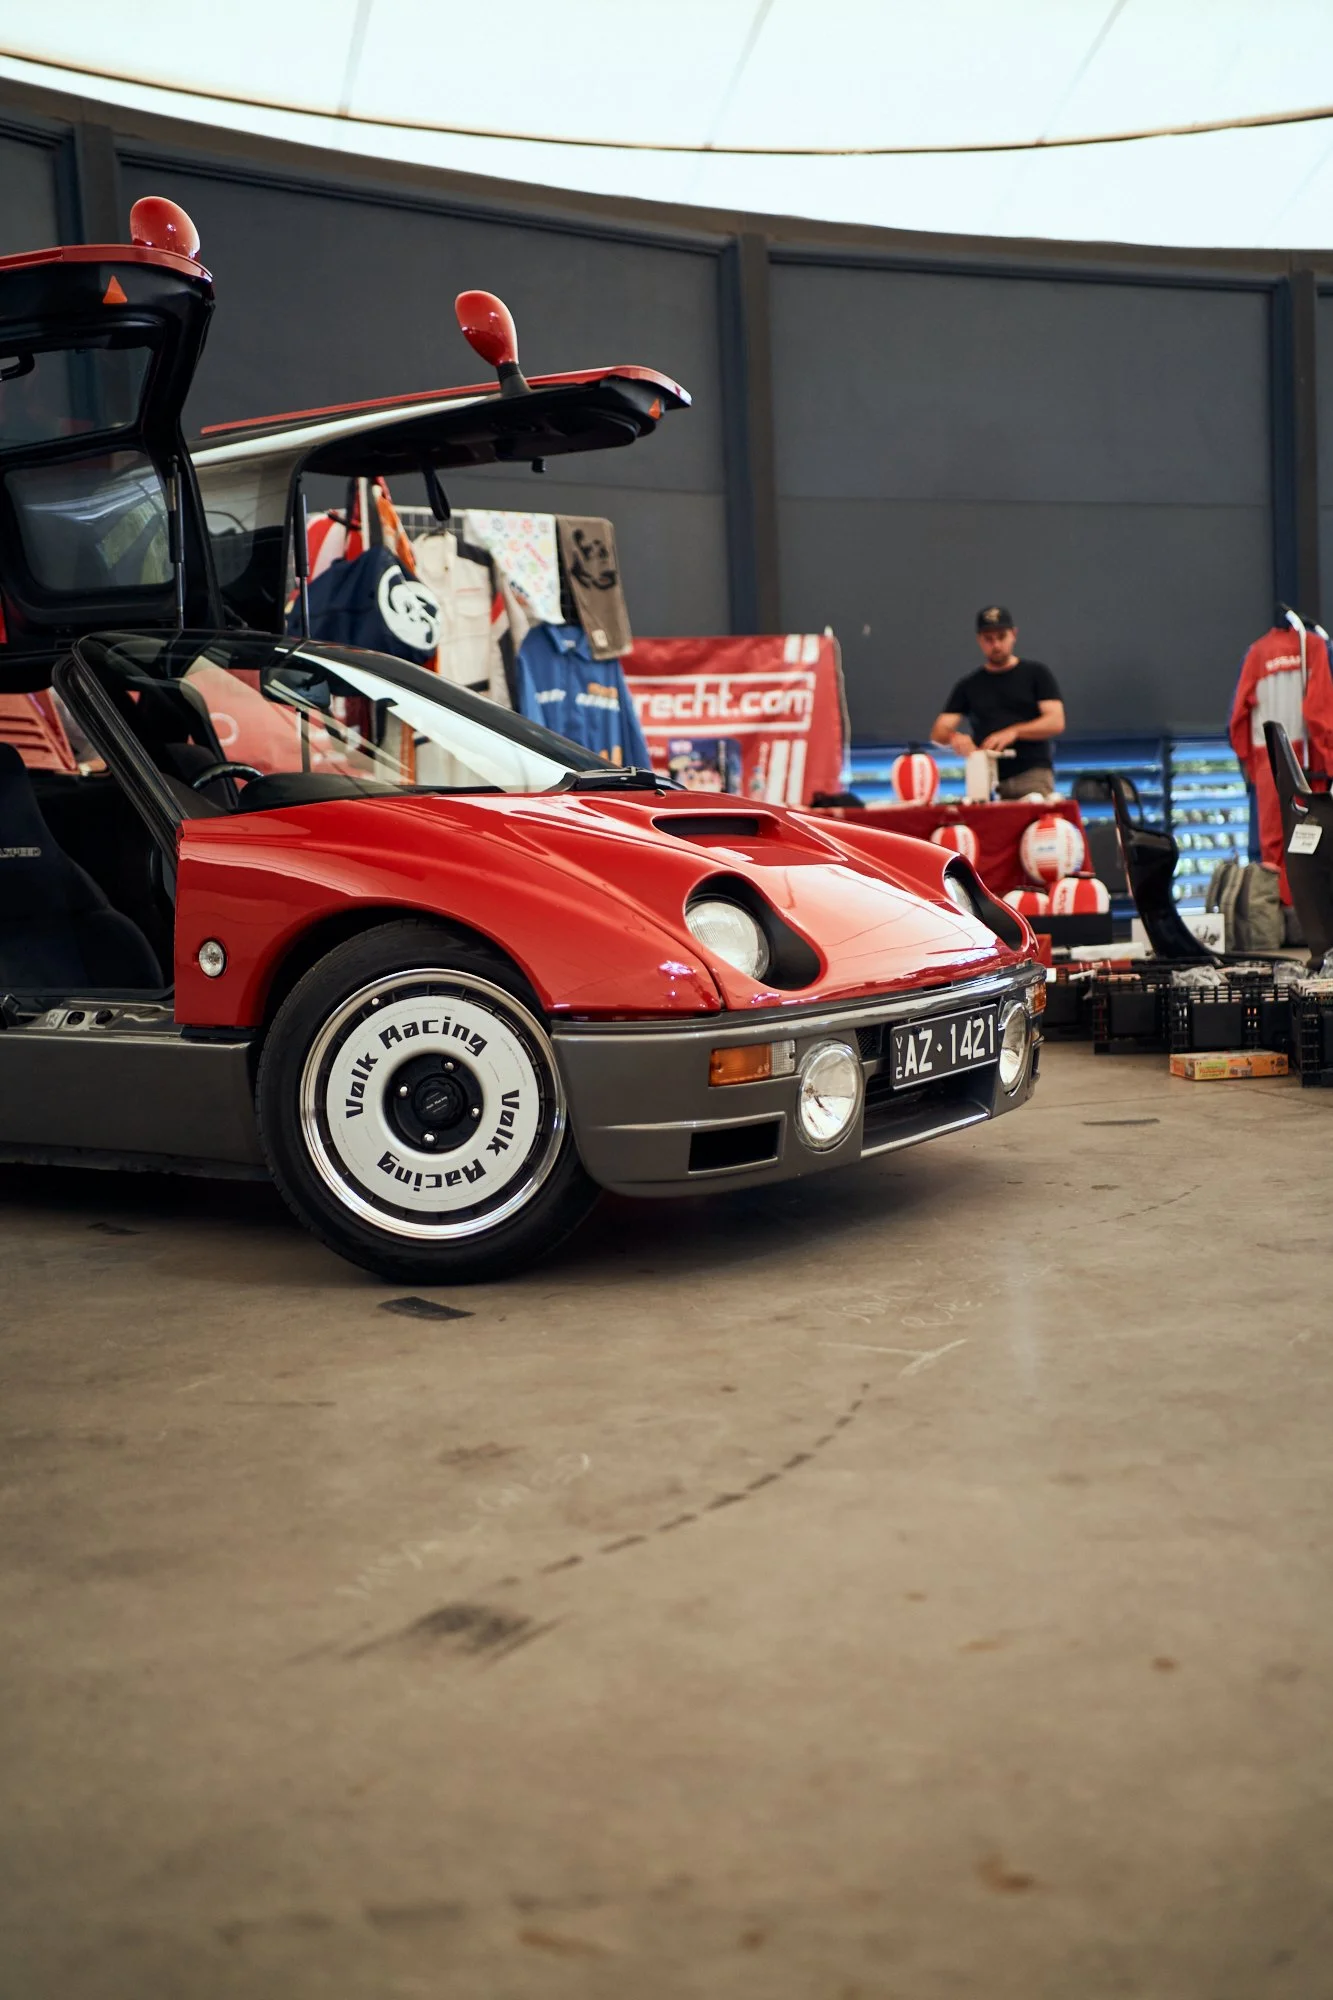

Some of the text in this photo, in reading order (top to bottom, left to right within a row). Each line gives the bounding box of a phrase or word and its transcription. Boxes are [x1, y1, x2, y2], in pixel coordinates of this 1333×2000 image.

[345, 1016, 488, 1119] Volk Racing
[376, 1089, 520, 1192] Volk Racing
